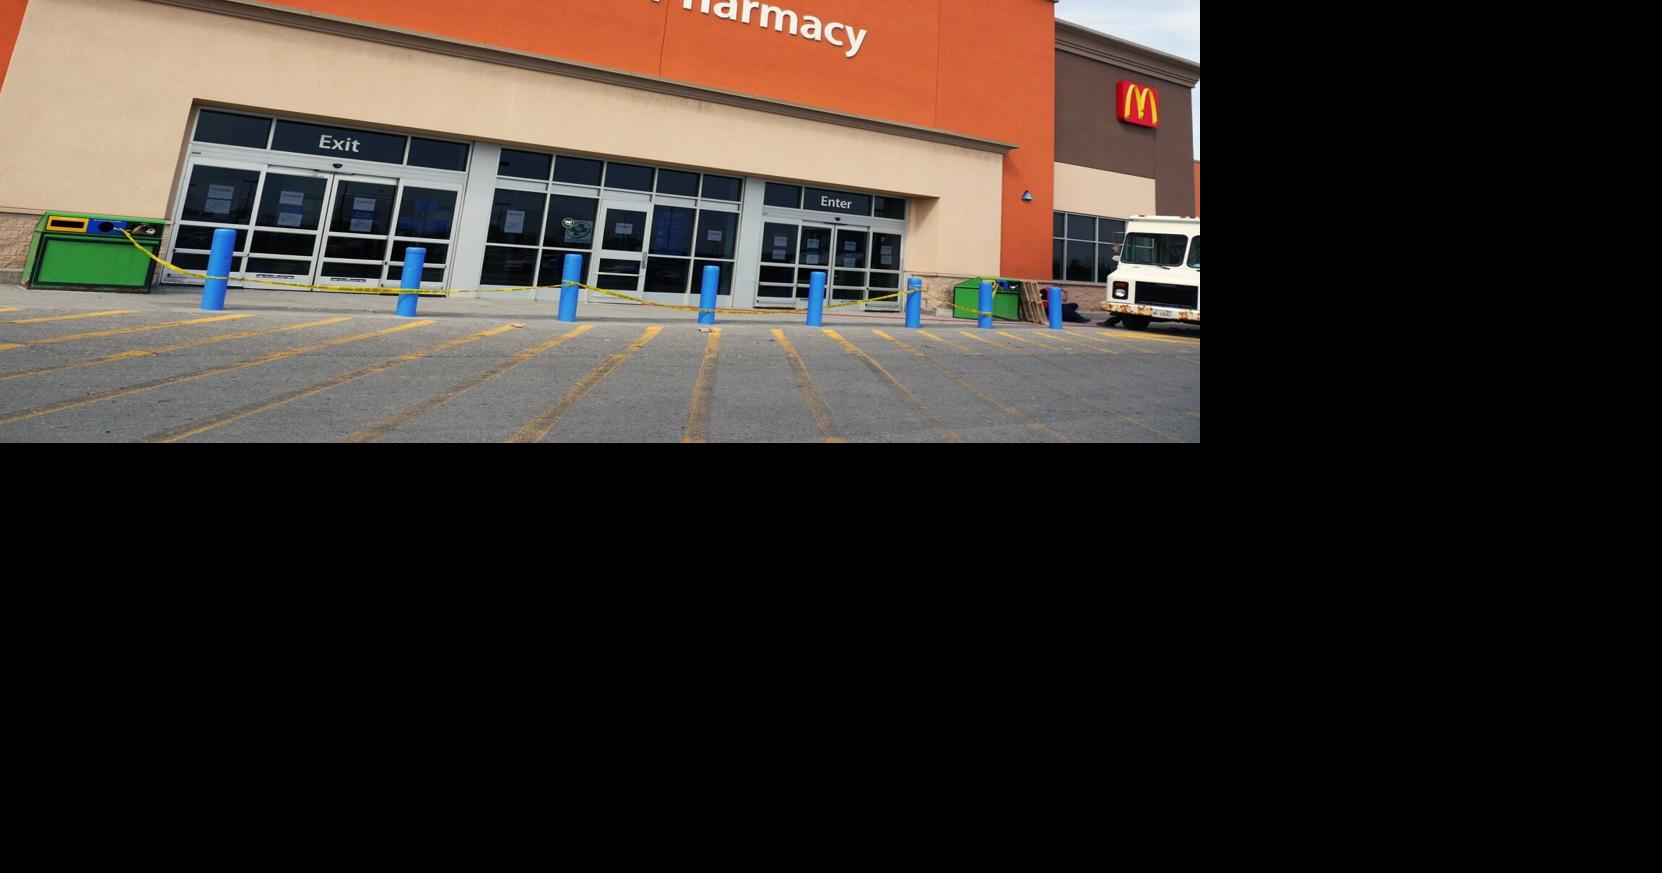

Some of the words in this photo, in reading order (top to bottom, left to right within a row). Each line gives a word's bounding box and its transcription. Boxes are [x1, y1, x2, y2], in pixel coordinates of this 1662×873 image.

[653, 0, 867, 58] armacy
[319, 134, 361, 152] Exit
[820, 195, 852, 209] Enter
